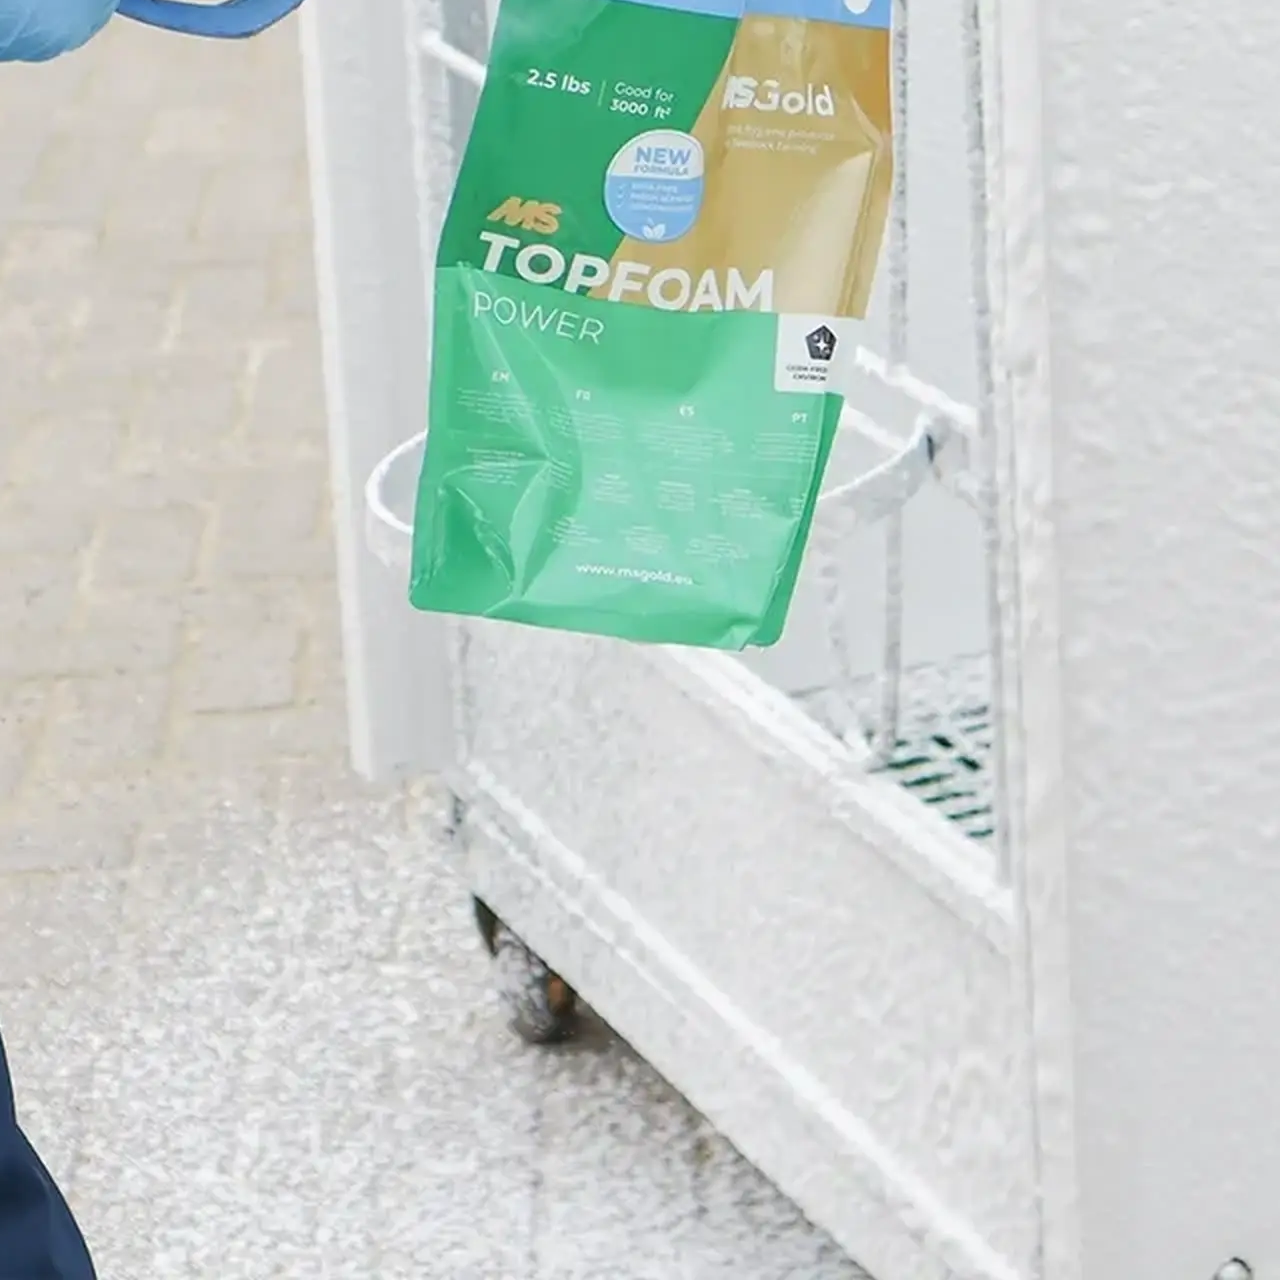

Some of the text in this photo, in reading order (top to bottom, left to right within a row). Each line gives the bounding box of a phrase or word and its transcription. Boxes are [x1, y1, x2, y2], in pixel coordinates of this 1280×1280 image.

[526, 68, 592, 95] 2.5 lbs
[614, 81, 675, 103] Good for
[610, 98, 649, 116] 3000
[635, 146, 691, 165] NEW
[633, 164, 689, 176] FORMULA
[486, 196, 563, 235] MS
[480, 231, 774, 313] TOPFOAM
[473, 291, 605, 345] POWER
[575, 563, 694, 587] www.msgold.eu
